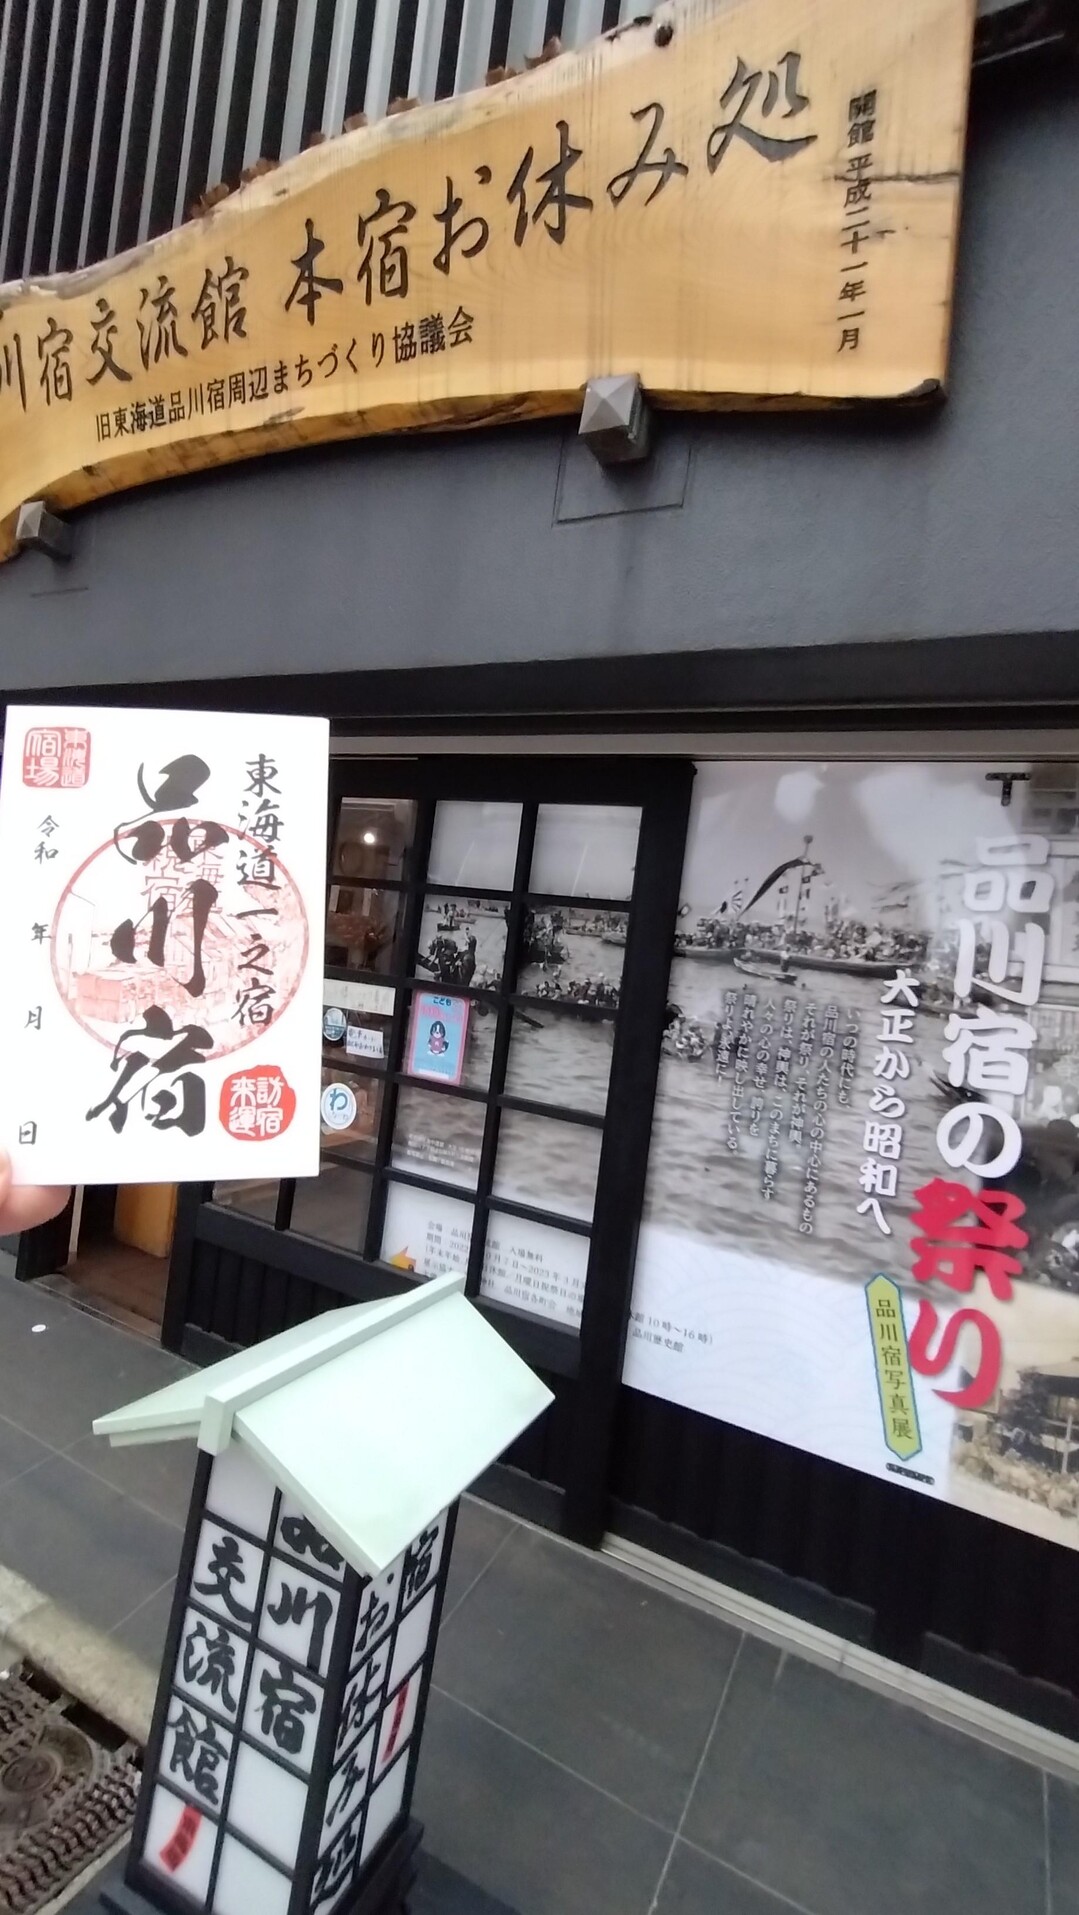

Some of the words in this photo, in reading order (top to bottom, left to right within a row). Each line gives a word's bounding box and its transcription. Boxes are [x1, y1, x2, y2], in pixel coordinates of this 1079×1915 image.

[0, 256, 250, 412] 川宿交流館
[96, 306, 474, 442] 旧東海道品川宿周辺まちづくり協議会
[34, 815, 60, 864] 令和
[231, 754, 285, 1027] 東海道一之宿
[31, 922, 53, 944] 年
[85, 753, 229, 1137] 品川宿
[24, 1006, 43, 1030] 月
[19, 1121, 38, 1146] 日
[856, 969, 921, 1235] 大正から昭和へ
[909, 834, 1055, 1408] 品川宿の祭り
[875, 1299, 913, 1440] 品川宿写真展
[167, 1536, 254, 1806] 交流館
